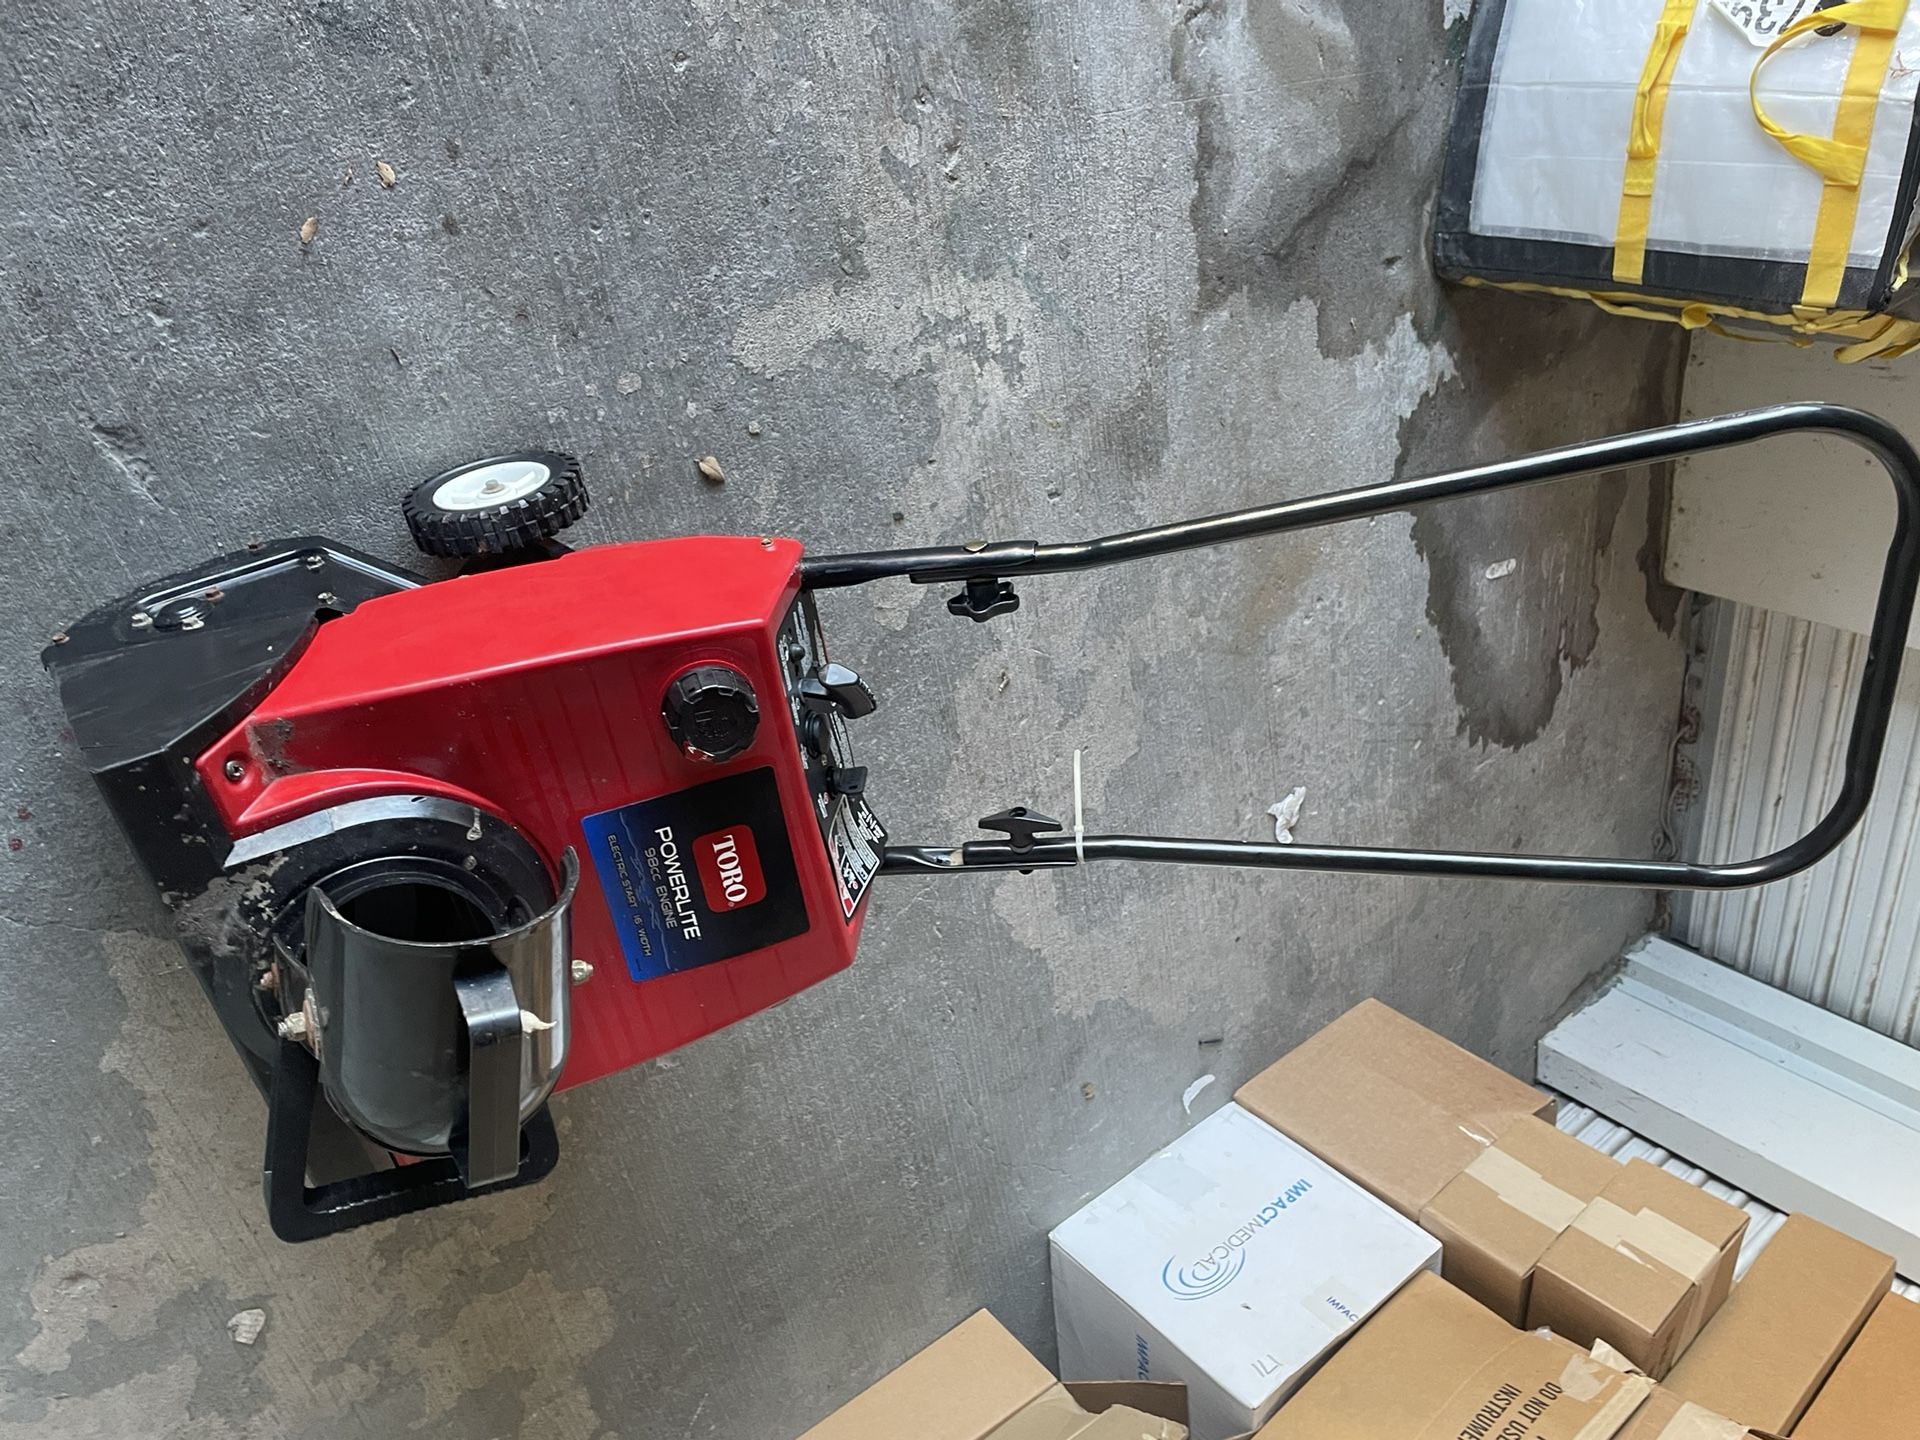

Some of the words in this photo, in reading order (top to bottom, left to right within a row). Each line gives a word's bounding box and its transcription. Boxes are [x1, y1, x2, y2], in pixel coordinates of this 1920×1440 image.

[607, 834, 628, 879] ELECTRIC
[621, 877, 638, 909] START
[655, 826, 700, 939] POWERLITE
[655, 885, 678, 929] ENGINE
[1517, 1396, 1550, 1424] NOT
